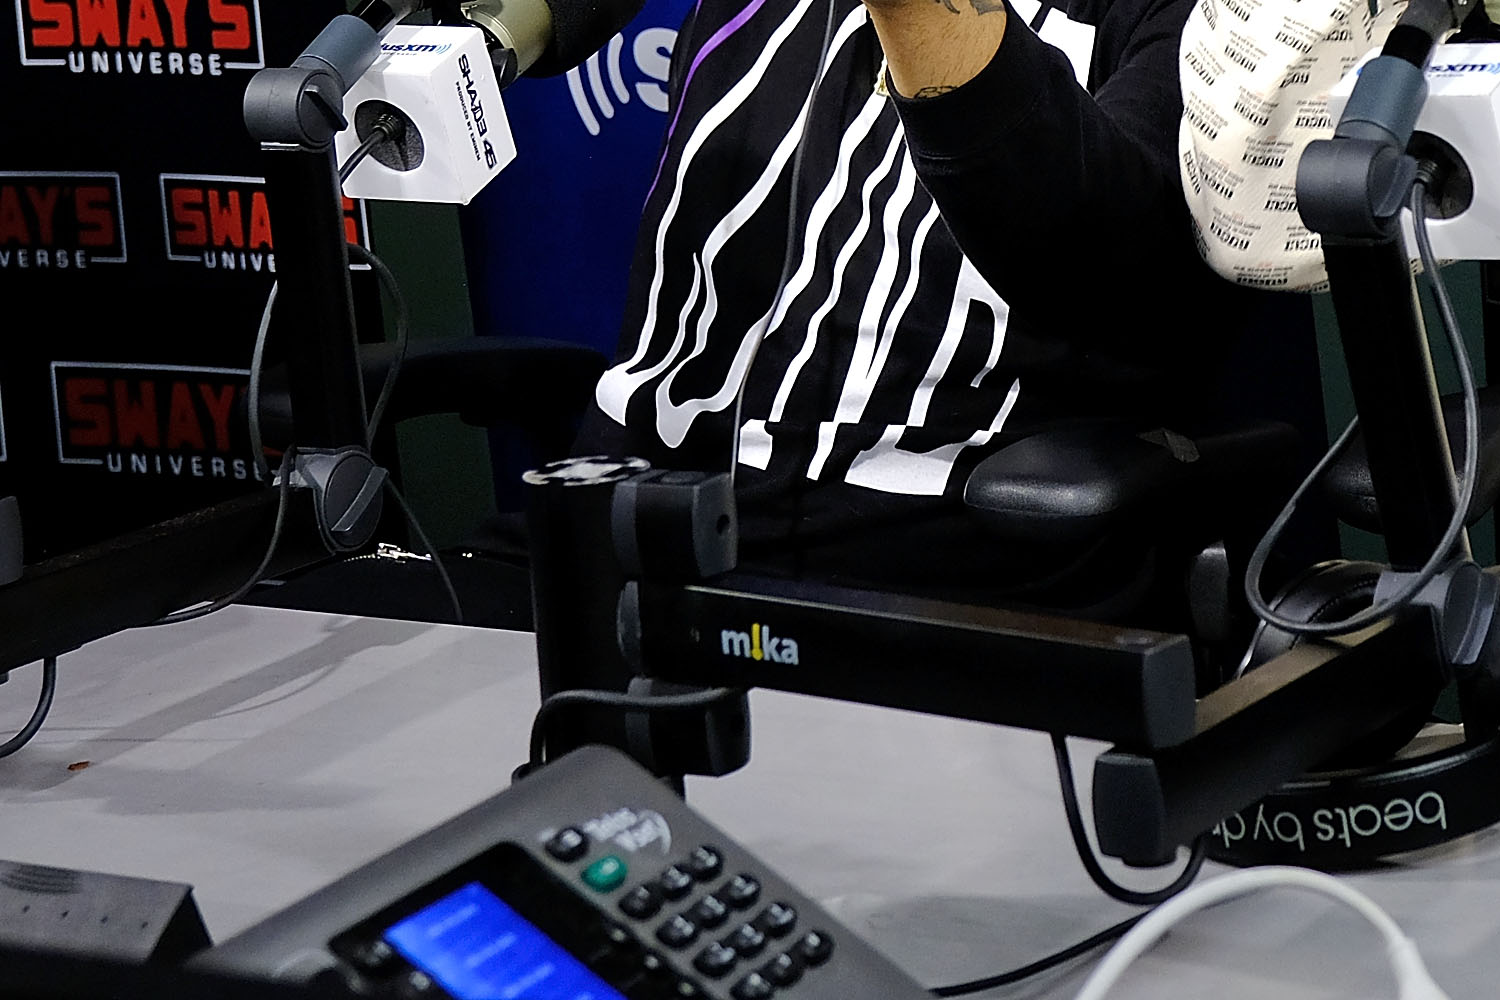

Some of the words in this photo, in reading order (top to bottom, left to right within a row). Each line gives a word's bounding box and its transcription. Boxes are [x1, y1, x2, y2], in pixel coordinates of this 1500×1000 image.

[69, 51, 222, 77] UNIVERSE
[458, 53, 488, 138] SHADE
[483, 138, 498, 171] 45
[0, 249, 88, 270] VERSE
[65, 377, 270, 453] SWAY
[1253, 803, 1305, 851] by
[1312, 790, 1448, 850] beats
